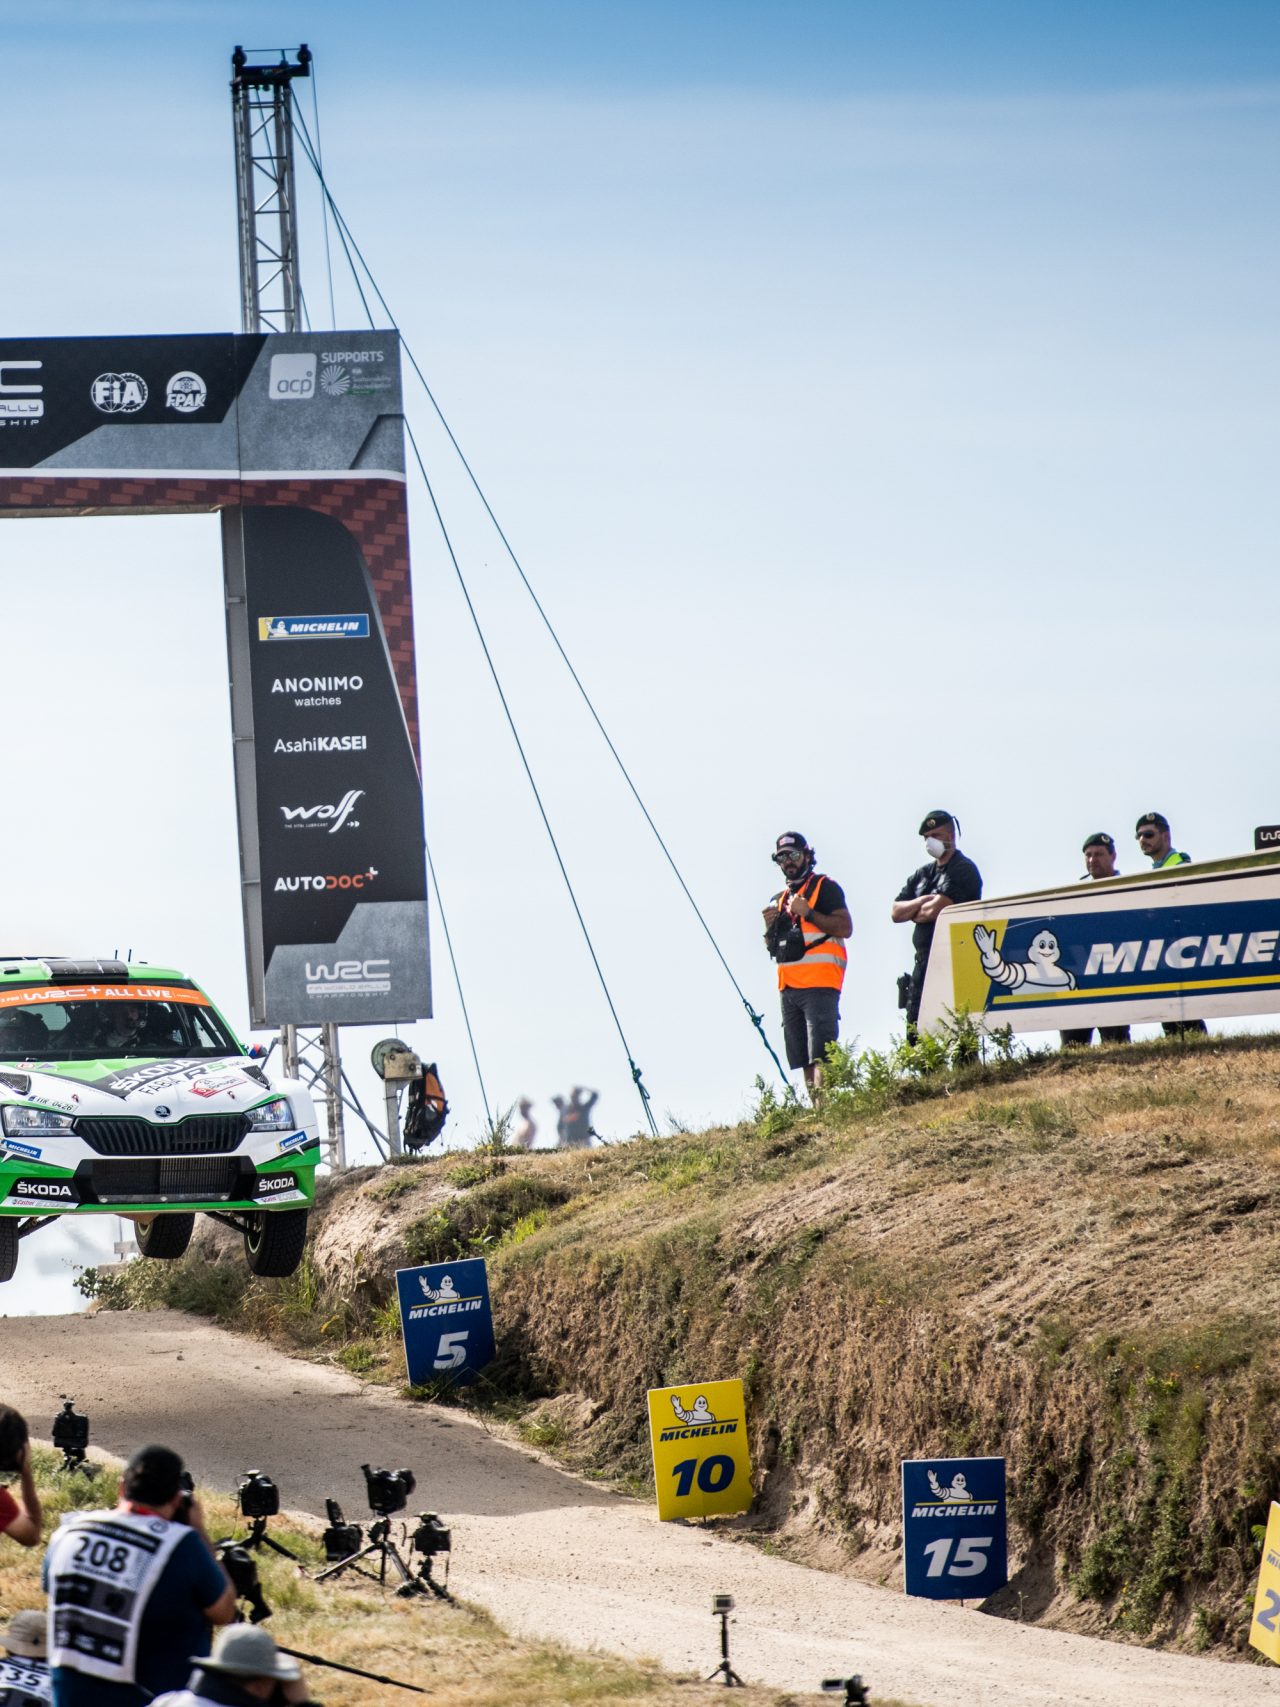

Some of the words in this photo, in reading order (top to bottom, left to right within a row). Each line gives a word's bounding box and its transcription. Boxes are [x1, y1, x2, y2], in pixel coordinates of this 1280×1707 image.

[321, 351, 385, 363] SUPPORTS
[277, 379, 312, 394] acp
[166, 393, 207, 407] FPAK
[290, 622, 360, 633] MICHELIN
[271, 676, 363, 693] ANONIMO
[295, 696, 342, 707] watches
[274, 735, 367, 753] AsahiKASEI
[1084, 930, 1280, 976] MICHE
[305, 959, 390, 980] WRC
[105, 988, 134, 997] ALL
[137, 988, 172, 998] LIVE
[7, 1144, 38, 1156] MICHELIN
[17, 1181, 72, 1196] ŠKODA
[258, 1177, 295, 1191] ŠKODA
[409, 1300, 482, 1320] MICHELIN
[433, 1331, 469, 1370] 5
[660, 1423, 737, 1442] MICHELIN
[672, 1454, 735, 1497] 10
[911, 1505, 997, 1518] MICHELIN
[72, 1536, 130, 1573] 208
[923, 1537, 993, 1578] 15
